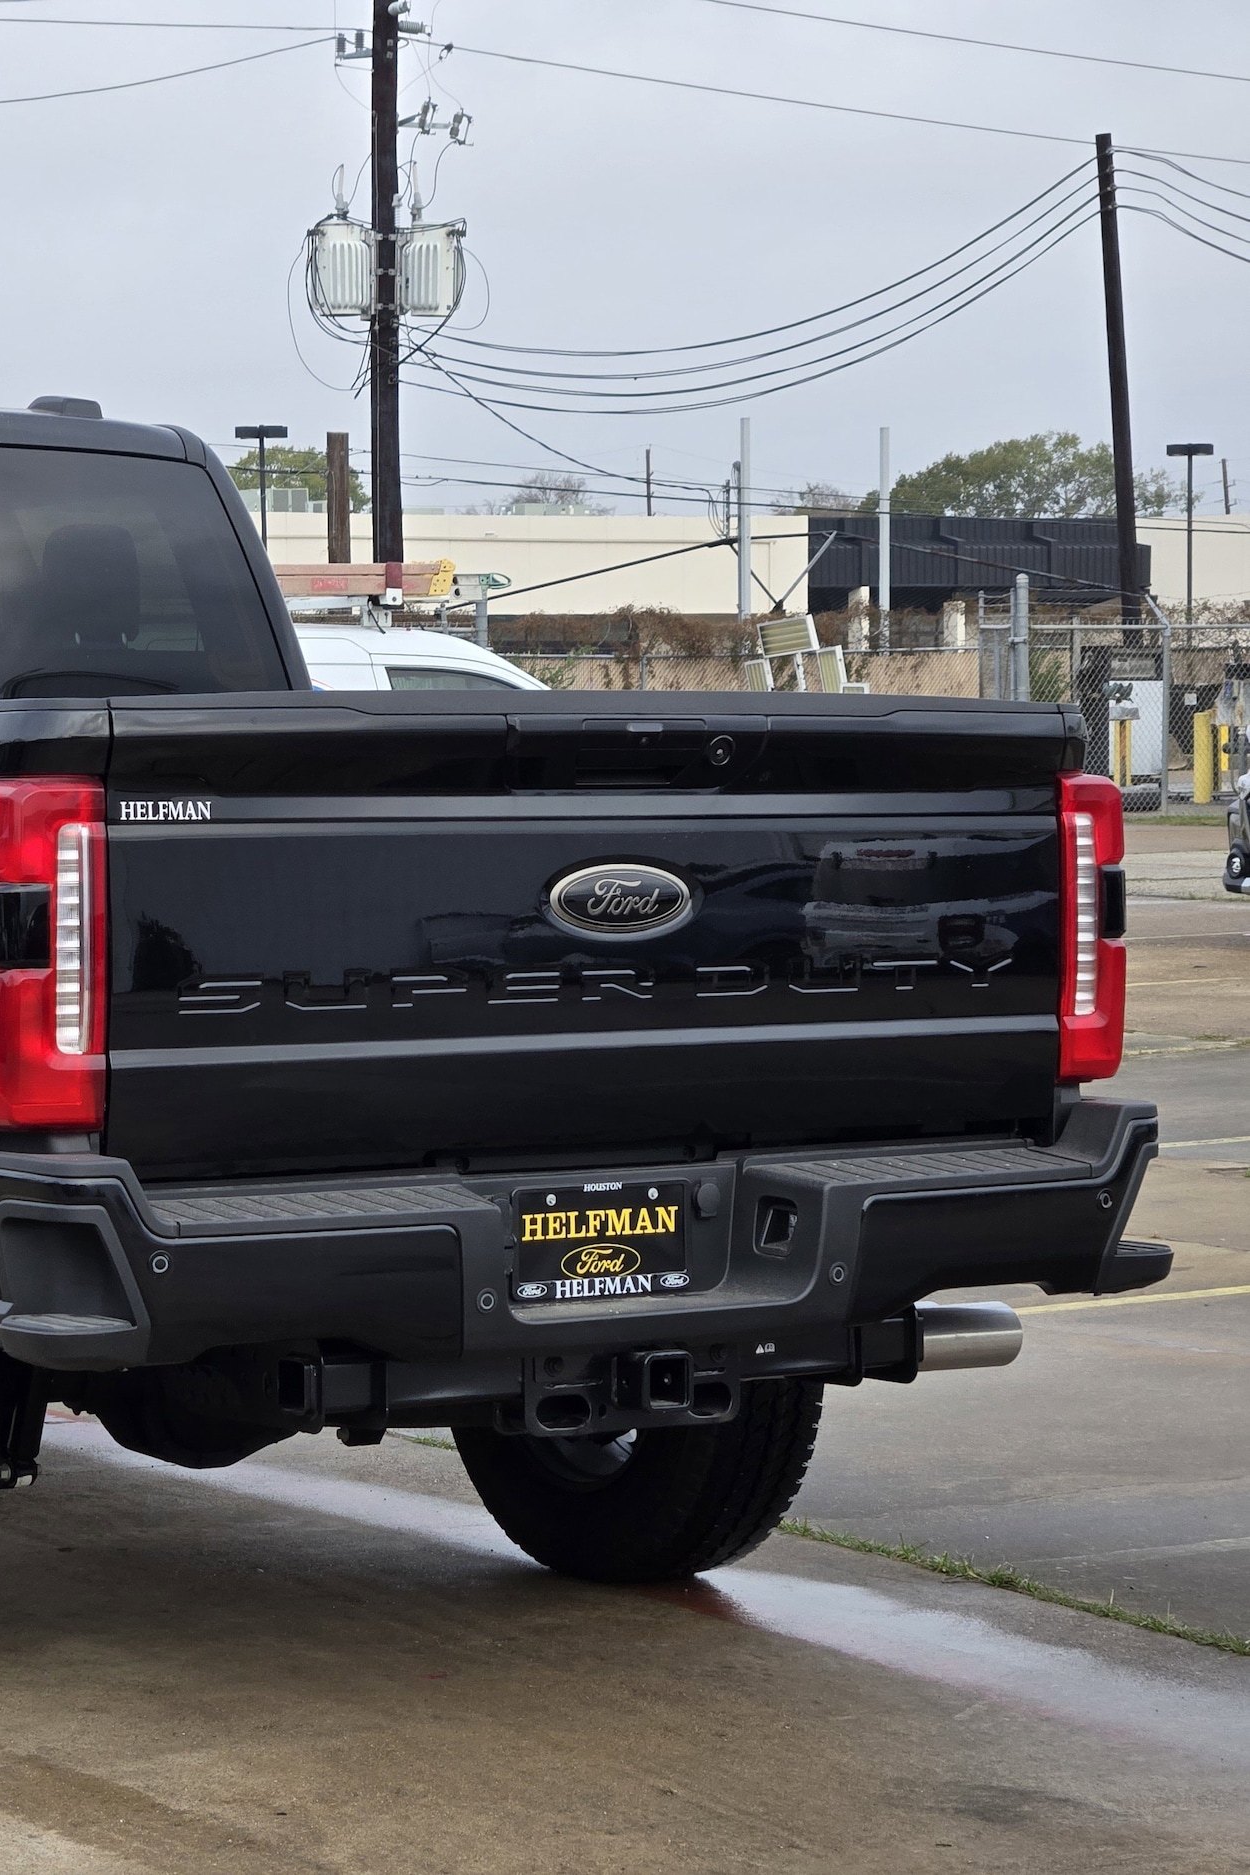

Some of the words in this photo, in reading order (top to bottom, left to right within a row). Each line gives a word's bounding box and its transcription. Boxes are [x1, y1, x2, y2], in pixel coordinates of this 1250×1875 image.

[120, 801, 211, 820] HELFMAN
[586, 878, 661, 916] Ford
[178, 965, 655, 1014] SUPER
[696, 955, 1013, 1000] DUTY
[582, 1181, 623, 1192] HOUSTON
[521, 1205, 679, 1242] HELFMAN
[576, 1247, 626, 1275] Ford
[554, 1273, 654, 1299] HELFMAN
